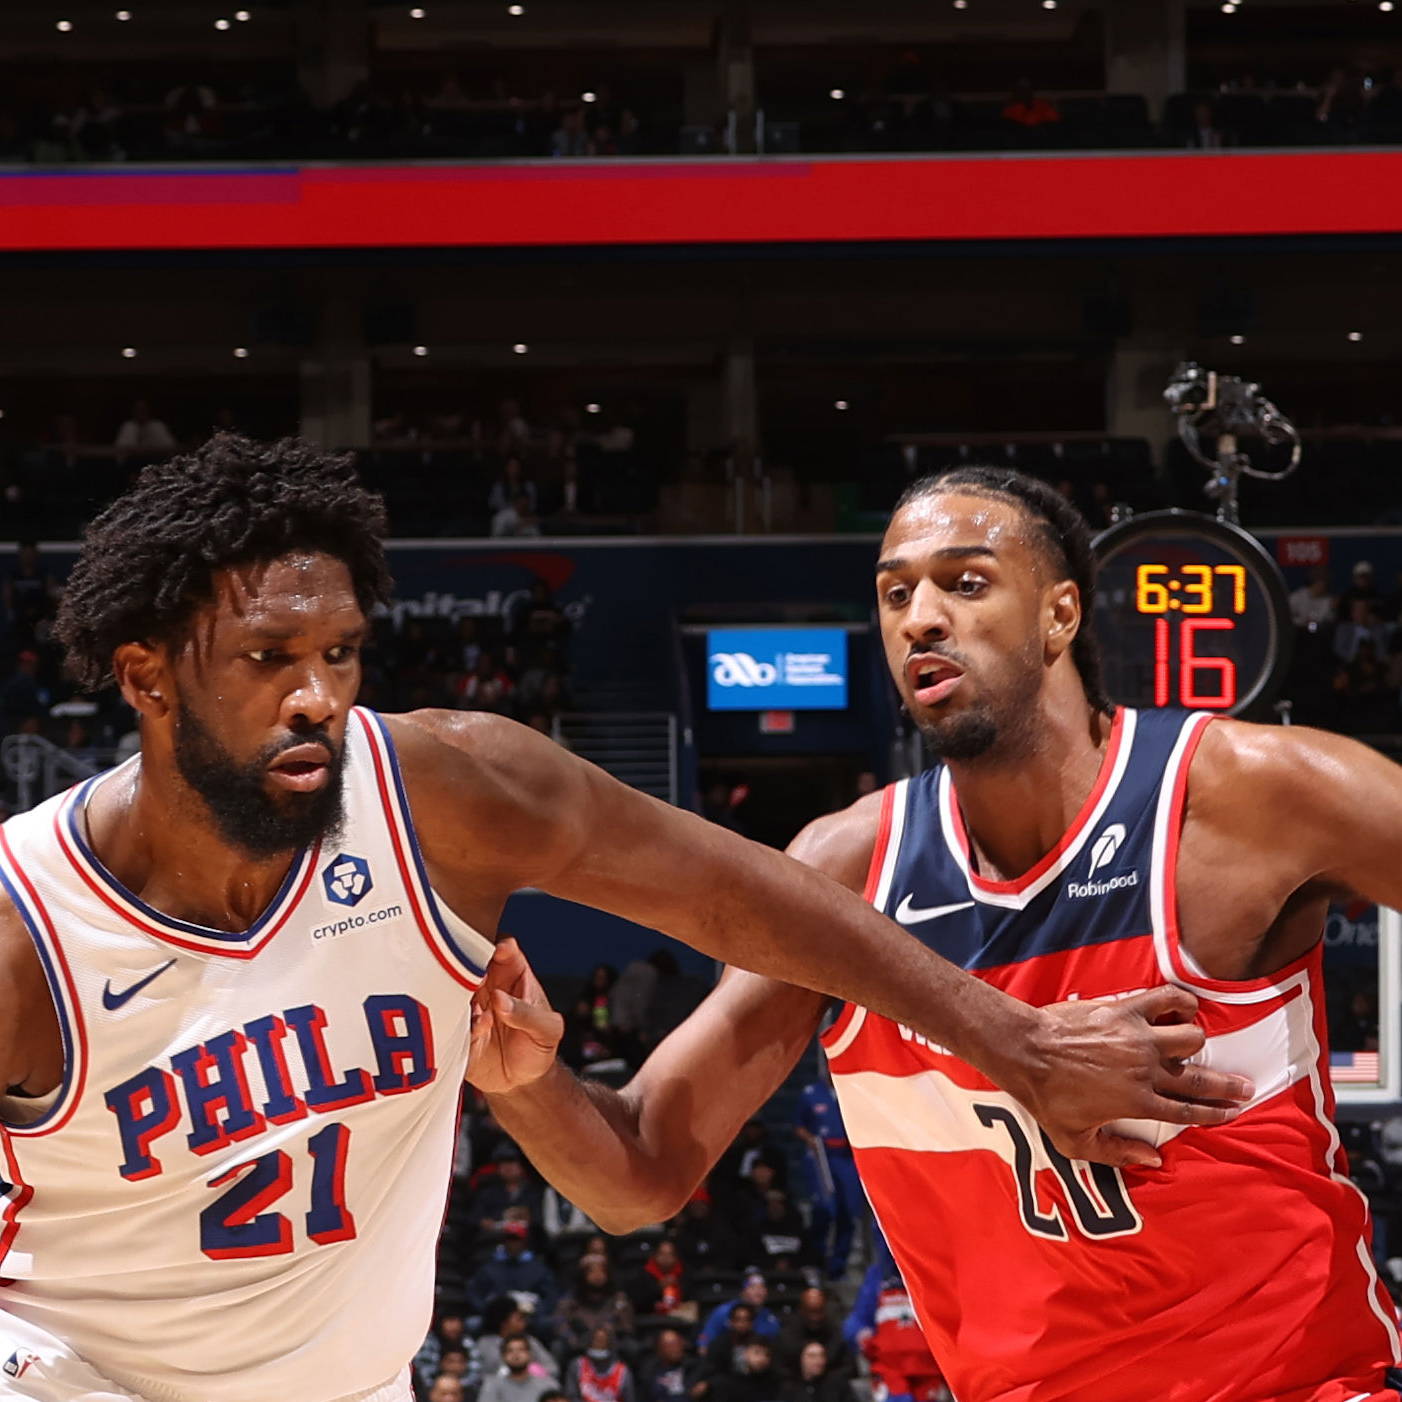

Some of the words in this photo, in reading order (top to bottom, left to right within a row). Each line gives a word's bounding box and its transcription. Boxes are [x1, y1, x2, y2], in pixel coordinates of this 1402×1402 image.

[1136, 564, 1247, 616] 6:37
[1154, 618, 1237, 709] 16
[1068, 871, 1139, 899] Robinood
[313, 905, 402, 939] crypto.com
[104, 994, 438, 1182] PHILA
[199, 1122, 357, 1261] 21
